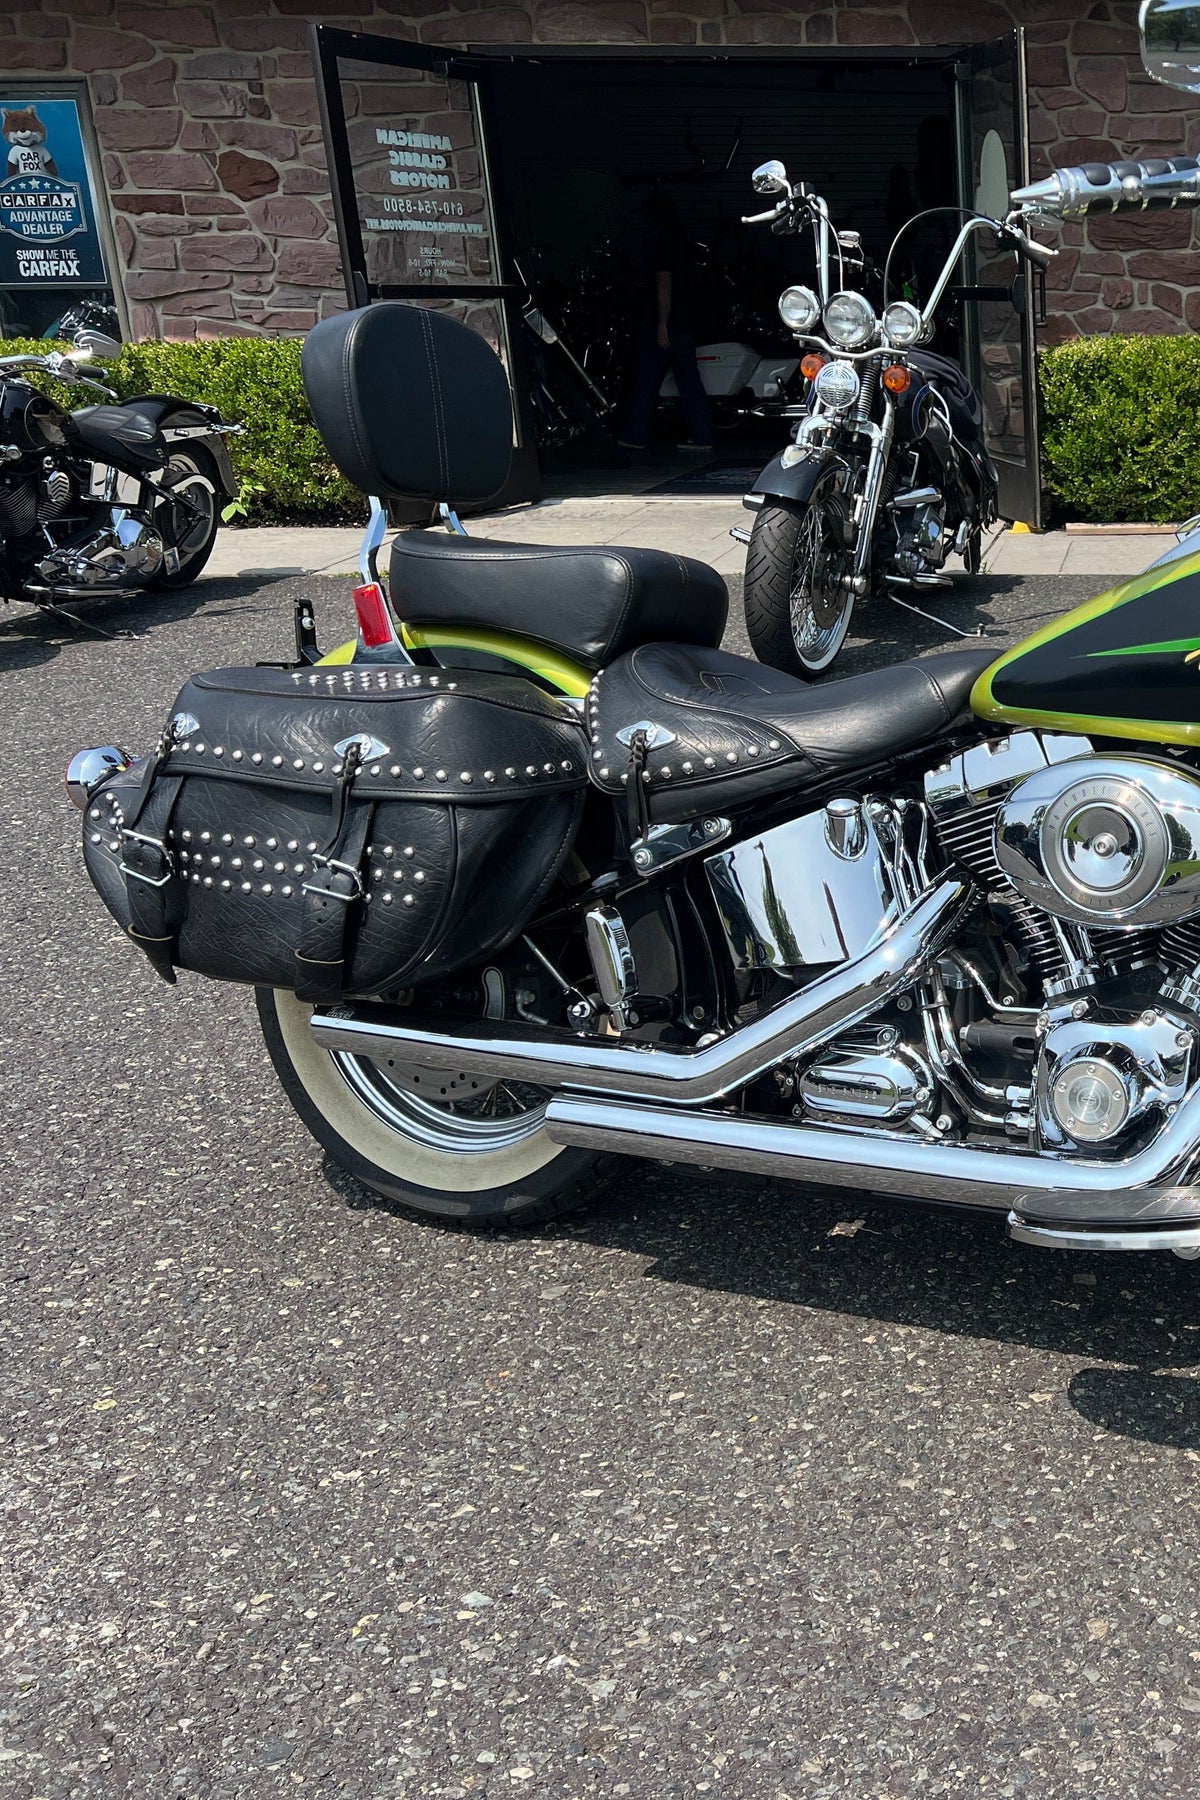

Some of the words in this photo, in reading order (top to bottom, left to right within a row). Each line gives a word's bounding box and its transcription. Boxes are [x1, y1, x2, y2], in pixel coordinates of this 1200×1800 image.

[20, 152, 39, 161] CAR
[23, 162, 41, 171] FOX
[2, 195, 72, 207] CARFAX
[10, 211, 73, 222] ADVANTAGE
[22, 223, 64, 235] DEALER
[16, 249, 45, 261] SHOW
[45, 249, 59, 260] ME
[60, 249, 77, 259] THE
[19, 261, 81, 277] CARFAX
